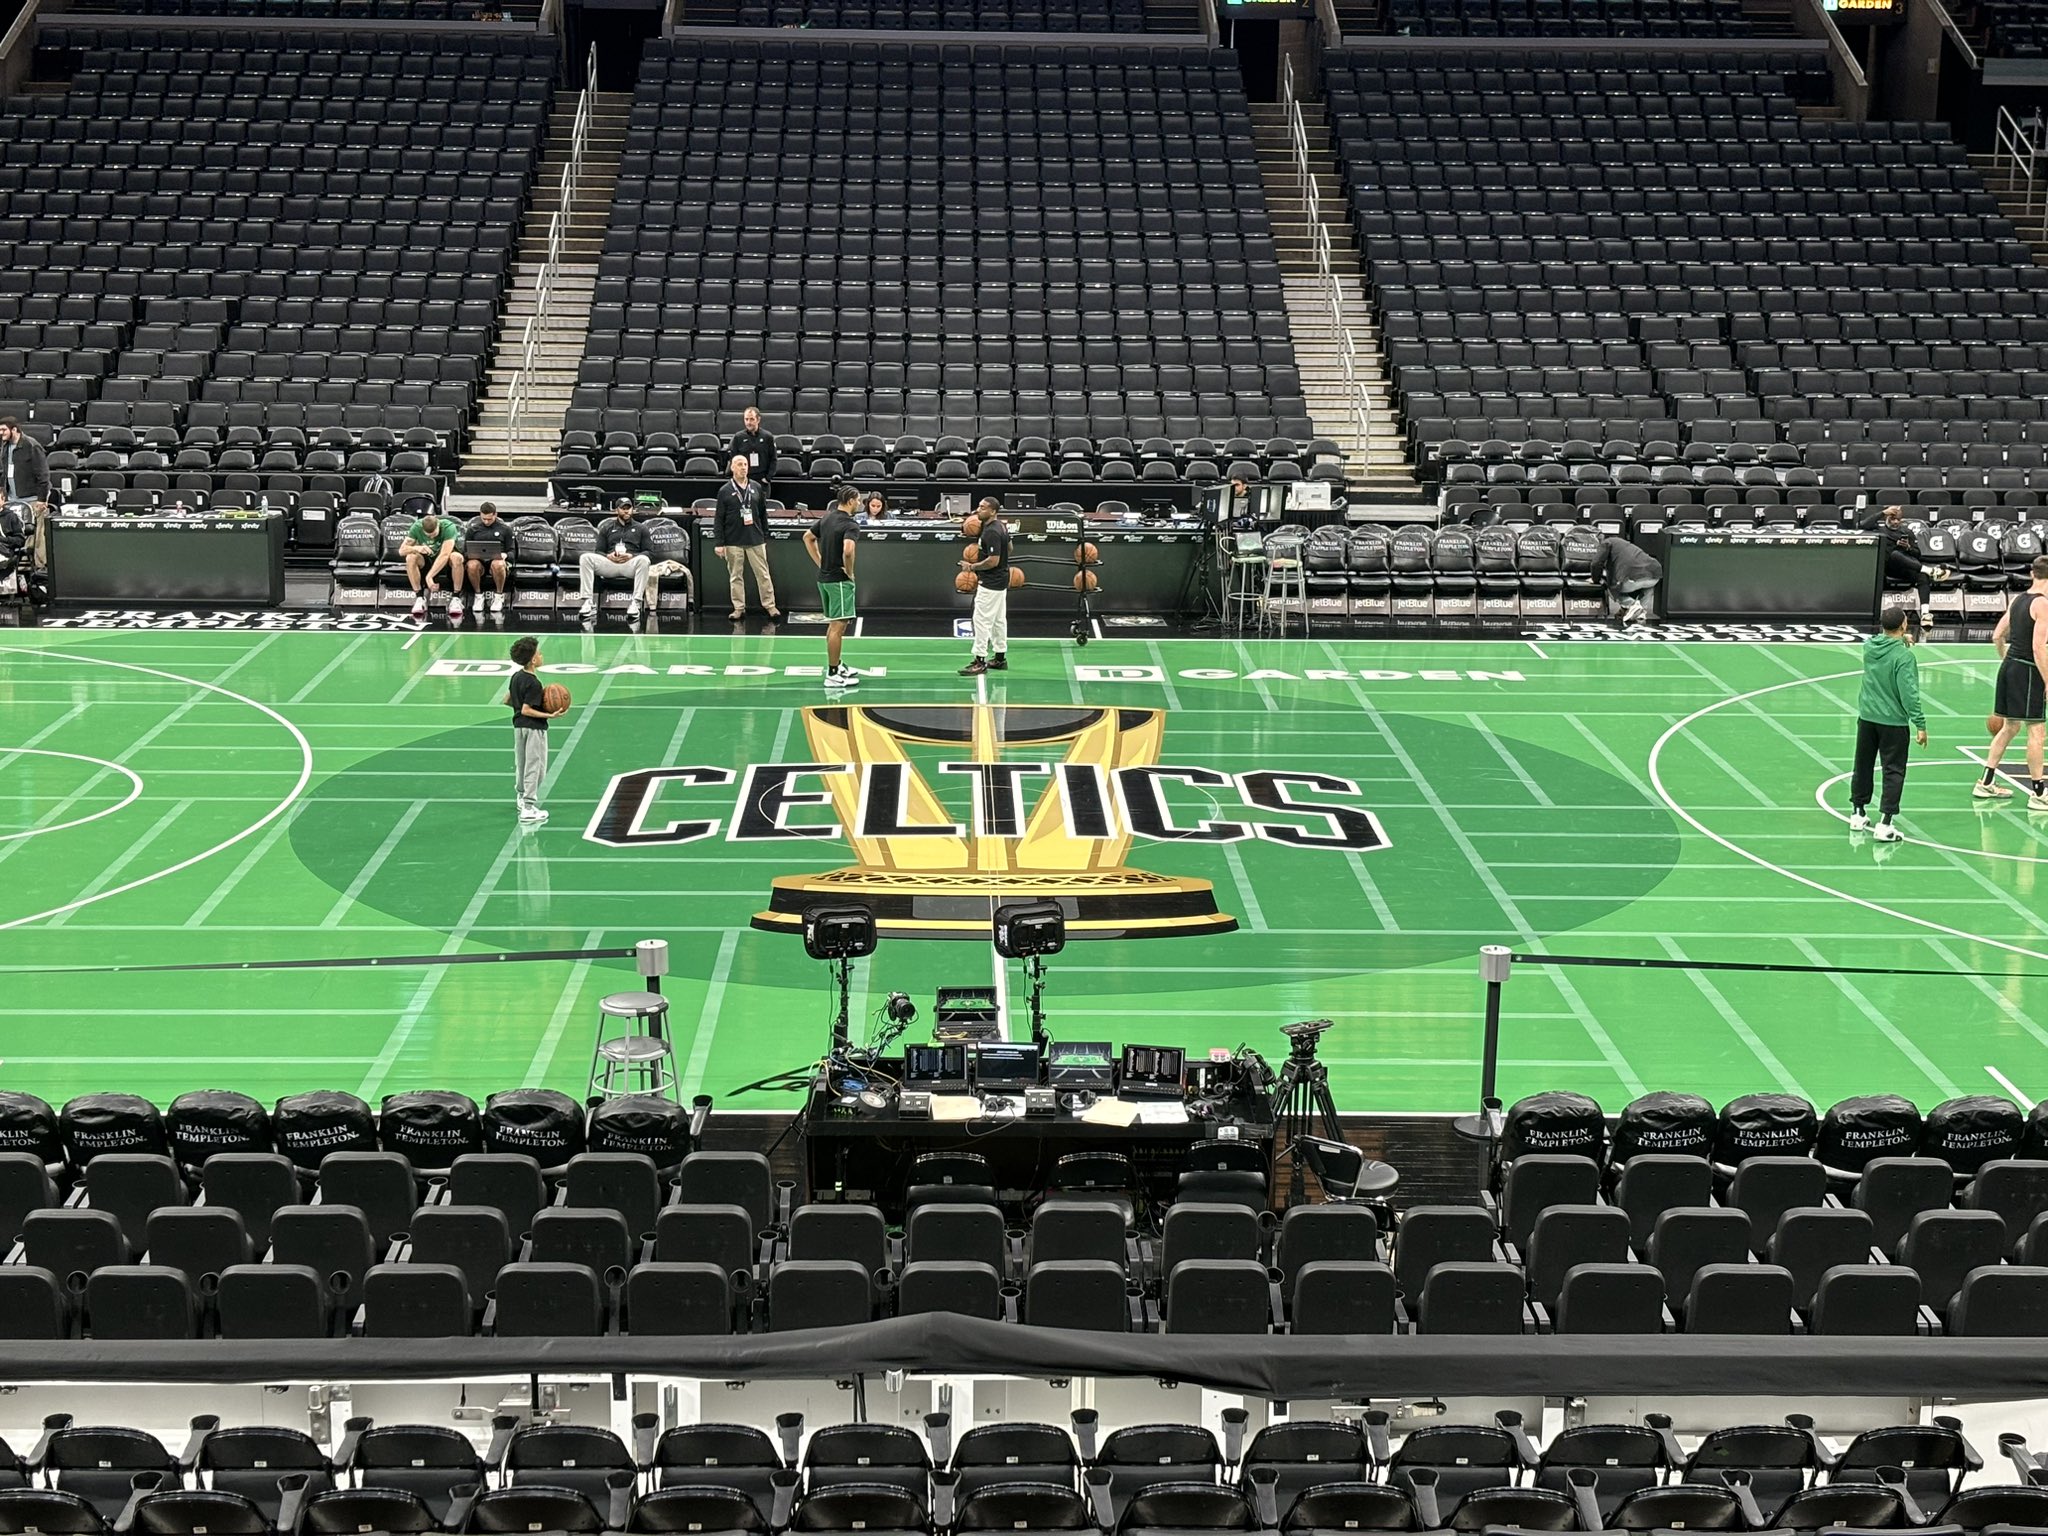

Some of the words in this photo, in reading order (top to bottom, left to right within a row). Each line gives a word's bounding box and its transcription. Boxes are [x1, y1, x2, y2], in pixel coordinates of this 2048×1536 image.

[1838, 0, 1893, 9] GARDEN
[1895, 2, 1903, 15] 3
[1046, 520, 1078, 530] Wilson
[1930, 535, 1944, 551] G
[1972, 537, 1988, 553] G
[2017, 533, 2031, 549] G
[340, 589, 372, 599] jetBlue
[384, 590, 416, 599] jetBlue
[518, 591, 549, 601] jetBlue
[1884, 594, 1916, 605] jetBlue
[1931, 594, 1958, 604] etBlue
[1312, 598, 1342, 608] jetBlue
[1354, 599, 1385, 608] jetBlue
[1398, 599, 1428, 609] jetBlue
[1440, 599, 1471, 609] jetBlue
[1483, 599, 1514, 609] jetBlue
[1527, 599, 1557, 609] jetBlue
[1570, 600, 1600, 610] jetBlue
[1970, 595, 2001, 605] jetBlue
[75, 610, 417, 622] FRANKLIN
[42, 618, 433, 631] TEMPLETON
[1536, 623, 1860, 633] FRANKLIN
[1178, 668, 1527, 681] GARDEN
[583, 762, 1394, 853] CELTICS
[74, 1129, 136, 1140] FRANKLIN
[179, 1124, 239, 1135] FRANKLIN
[286, 1124, 348, 1141] FRANKLIN
[400, 1124, 461, 1138] FRANKLIN
[500, 1125, 560, 1139] FRANKLIN
[1529, 1128, 1589, 1139] FRANKLIN
[1643, 1127, 1702, 1140] FRANKLIN
[1739, 1127, 1799, 1139] FRANKLIN
[1845, 1127, 1905, 1140] FRANKLIN
[1948, 1129, 2007, 1141] FRANKLIN
[607, 1132, 668, 1145] FRANKLIN
